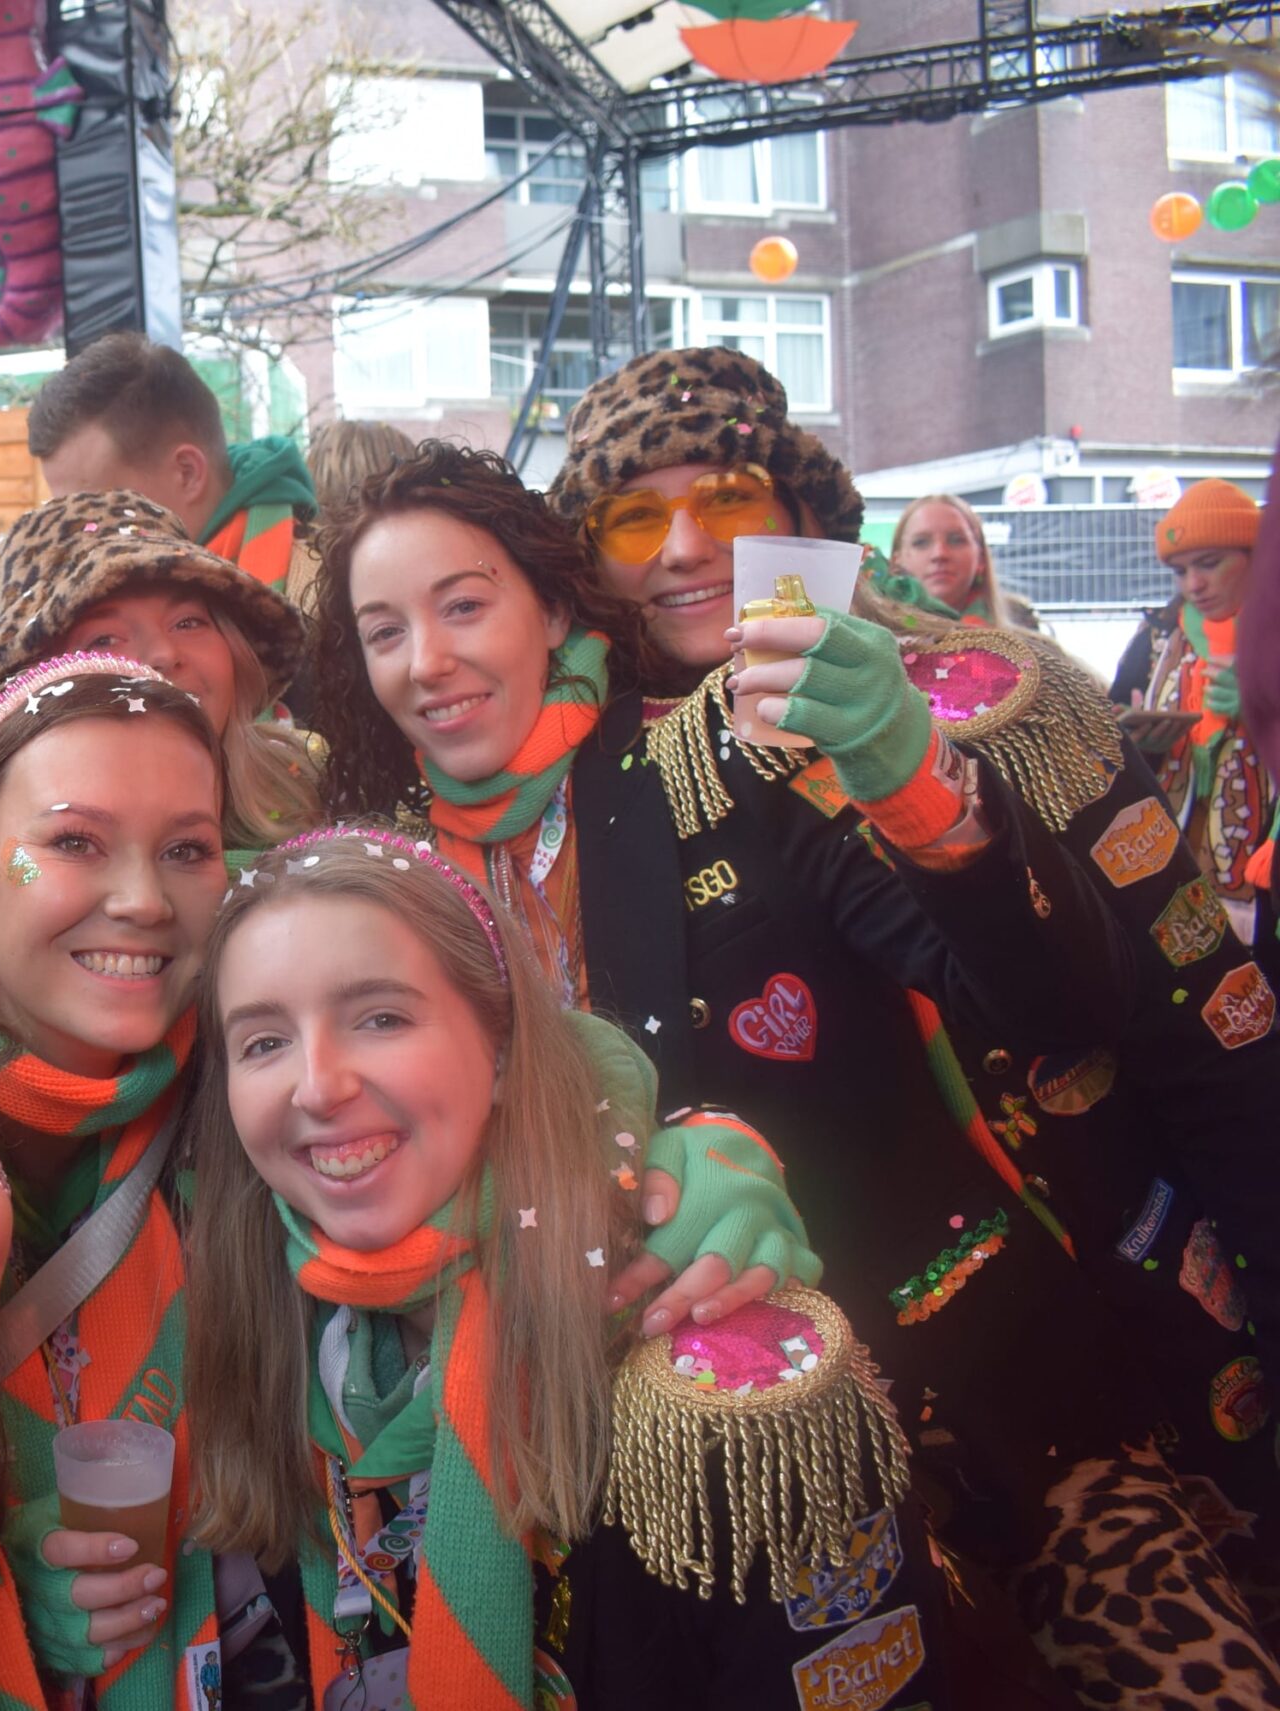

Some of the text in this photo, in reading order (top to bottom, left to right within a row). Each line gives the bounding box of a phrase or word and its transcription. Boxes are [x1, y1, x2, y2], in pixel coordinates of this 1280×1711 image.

[1112, 814, 1172, 868] Baret
[1170, 894, 1220, 951] Baret
[1220, 974, 1270, 1031] Baret
[774, 1016, 812, 1055] POWER
[1123, 1183, 1170, 1257] Kruikenstad
[823, 1626, 916, 1703] Baret
